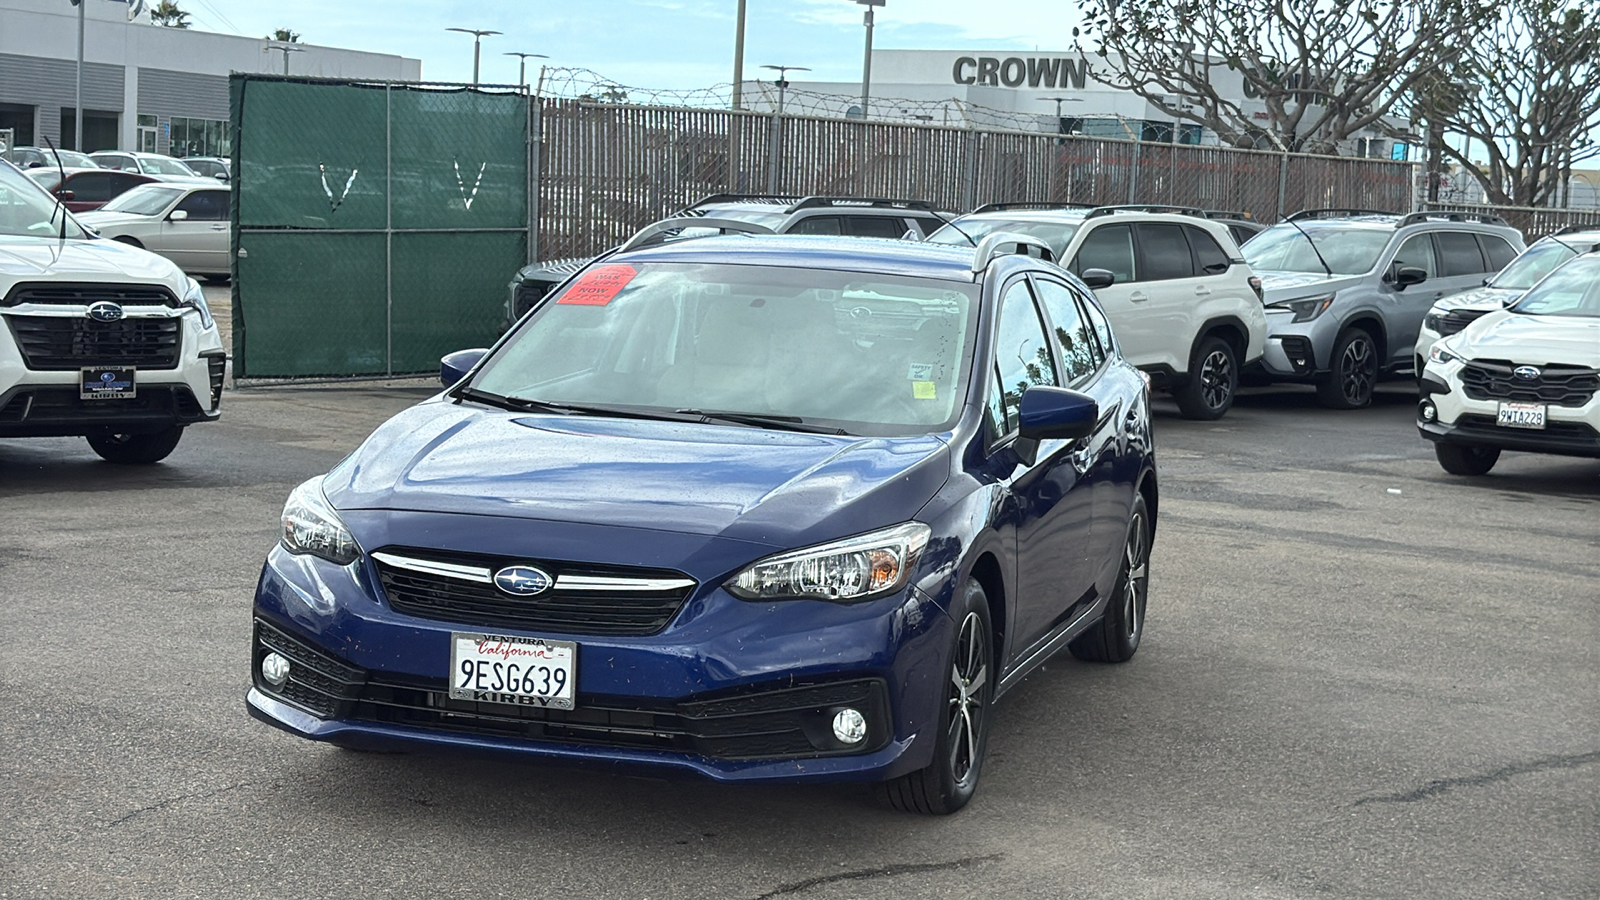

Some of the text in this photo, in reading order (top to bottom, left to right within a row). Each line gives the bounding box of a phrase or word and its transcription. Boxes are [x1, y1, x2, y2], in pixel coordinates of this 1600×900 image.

[953, 56, 1086, 89] CROWN
[1500, 410, 1543, 425] 9WIA228
[483, 634, 546, 646] VENTURA
[478, 640, 553, 660] California
[460, 659, 567, 697] 9ESG639
[473, 690, 552, 707] KIRBY
